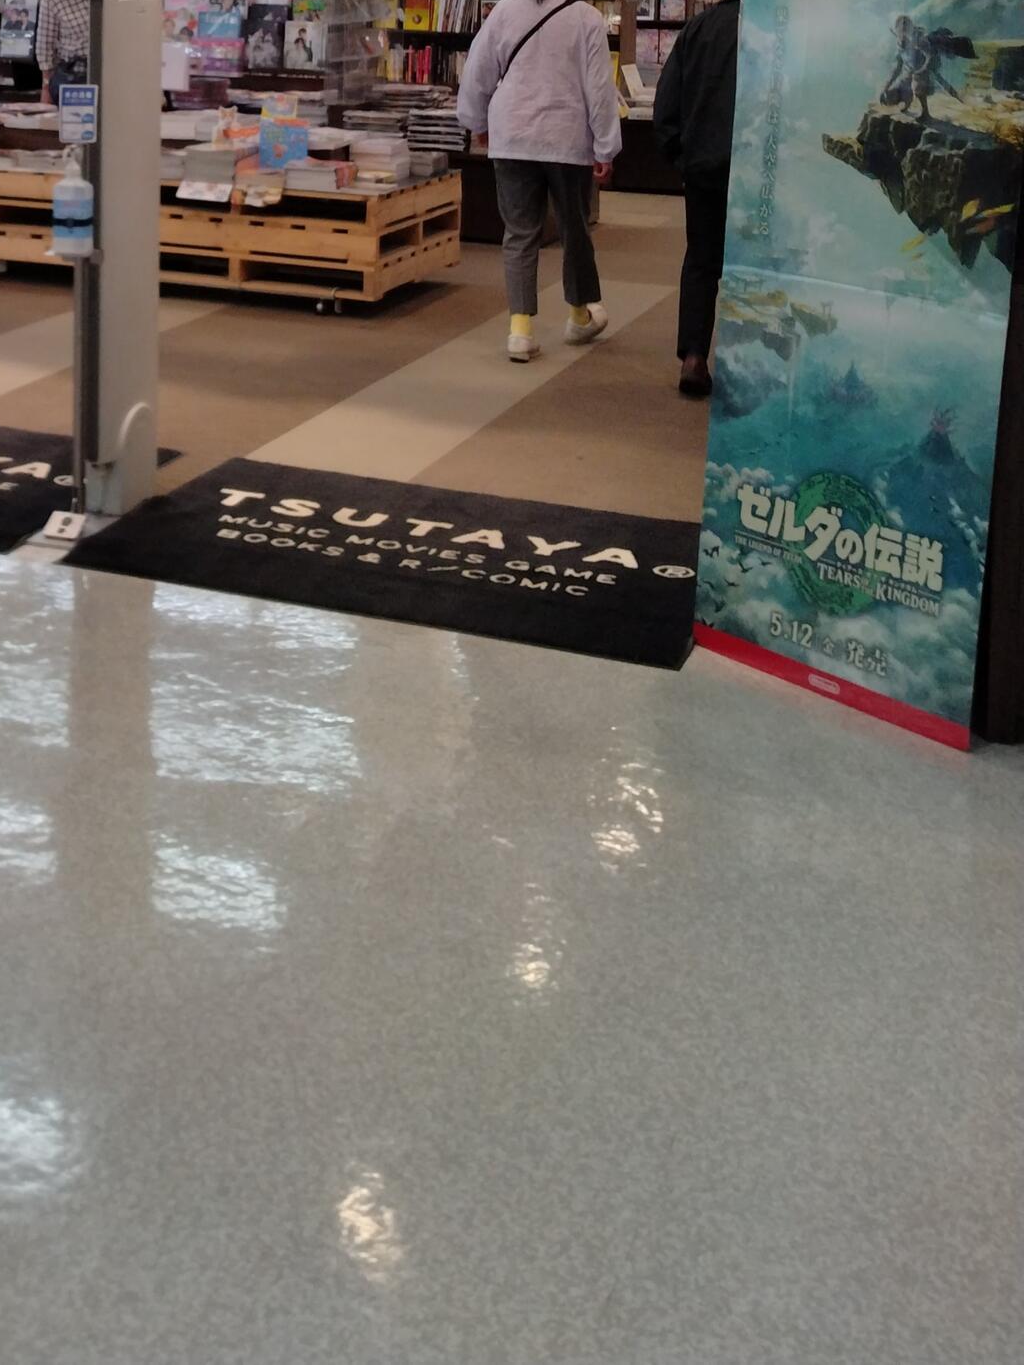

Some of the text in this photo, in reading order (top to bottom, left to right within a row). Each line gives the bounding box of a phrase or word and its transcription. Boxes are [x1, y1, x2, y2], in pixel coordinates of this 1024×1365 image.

[216, 528, 345, 558] BOOKS
[356, 552, 382, 565] &
[219, 488, 640, 570] TSUTAYA
[219, 514, 618, 586] MUSIC MOVIES GAME
[737, 484, 944, 593] ゼルダの伝説
[816, 561, 862, 587] TEARS
[875, 582, 941, 618] KINGDOM
[770, 612, 814, 648] 5.12
[847, 639, 888, 677] 発売
